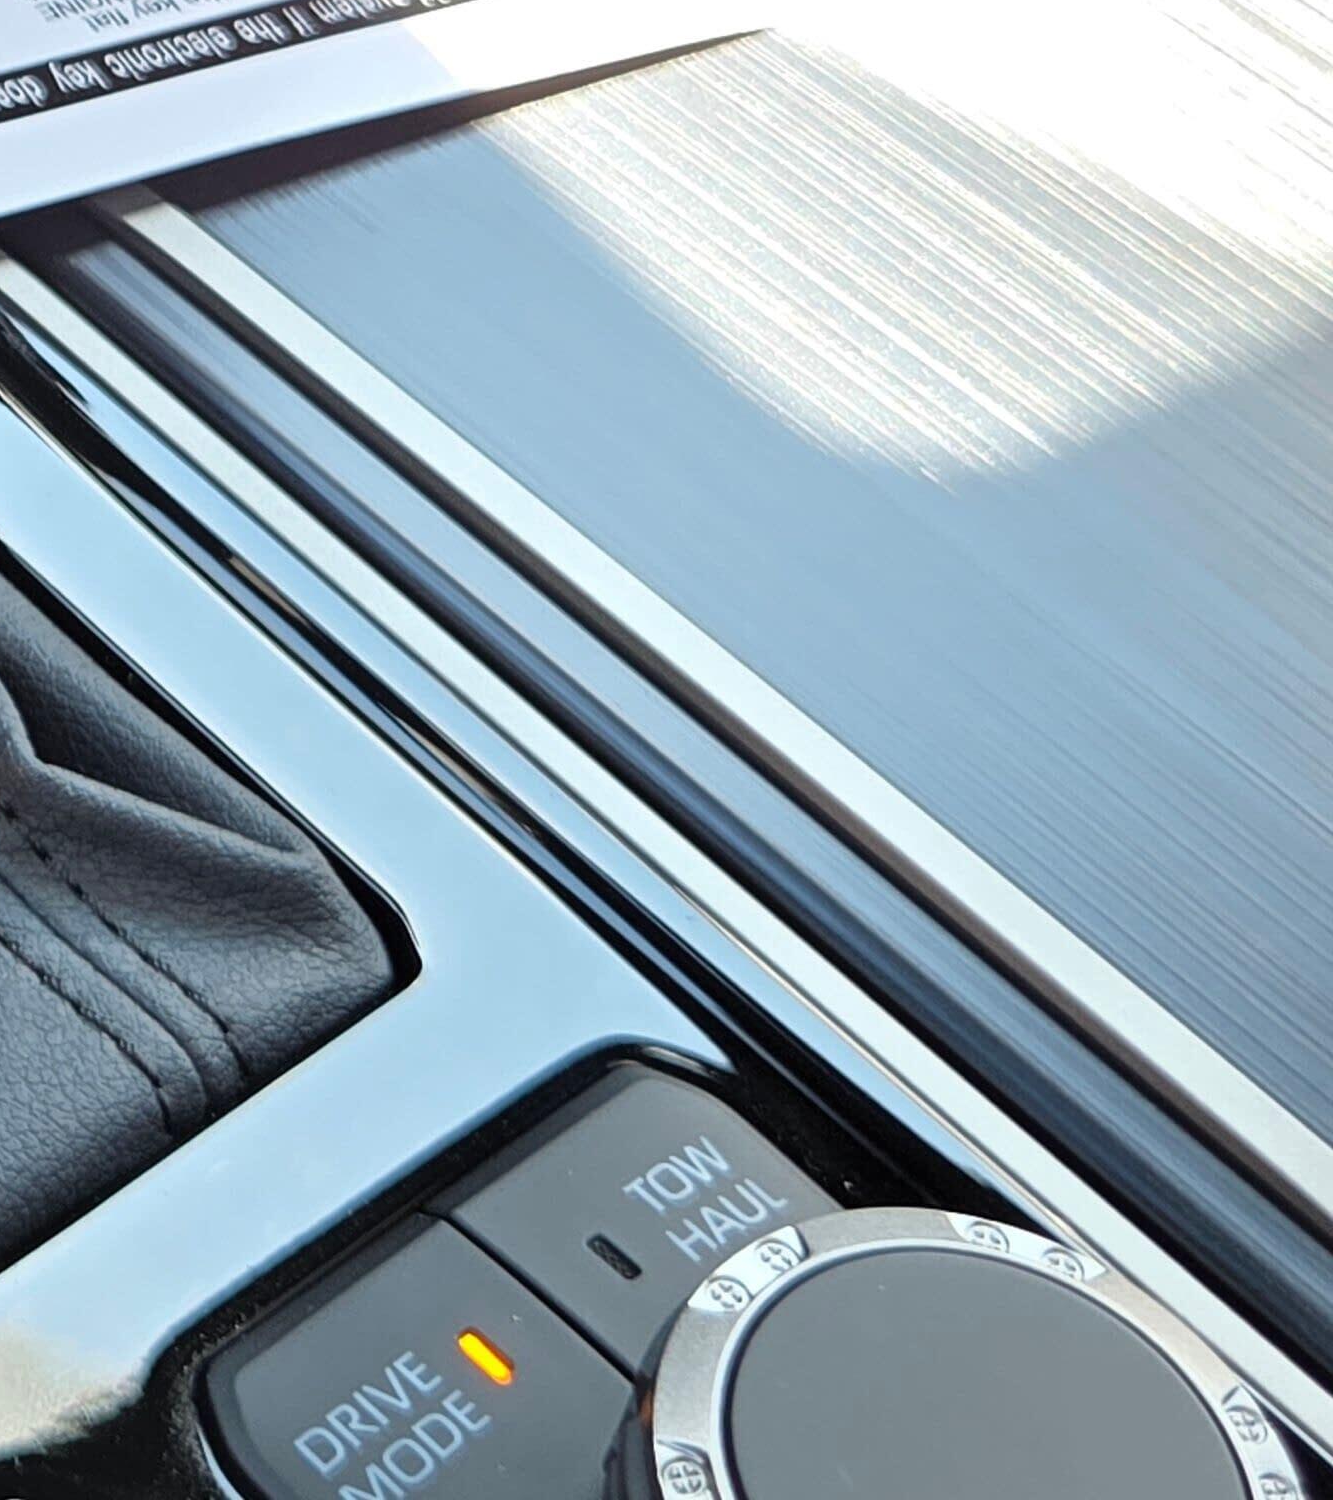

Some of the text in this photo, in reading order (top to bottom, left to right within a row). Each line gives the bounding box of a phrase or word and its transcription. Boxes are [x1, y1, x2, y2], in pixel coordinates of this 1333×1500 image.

[83, 8, 129, 31] flat
[234, 14, 284, 42] the
[49, 61, 106, 90] key
[105, 27, 230, 77] electronic
[622, 1135, 730, 1213] TOW
[665, 1178, 788, 1263] HAUL
[293, 1350, 443, 1475] DRIVE
[338, 1389, 492, 1500] MODE
